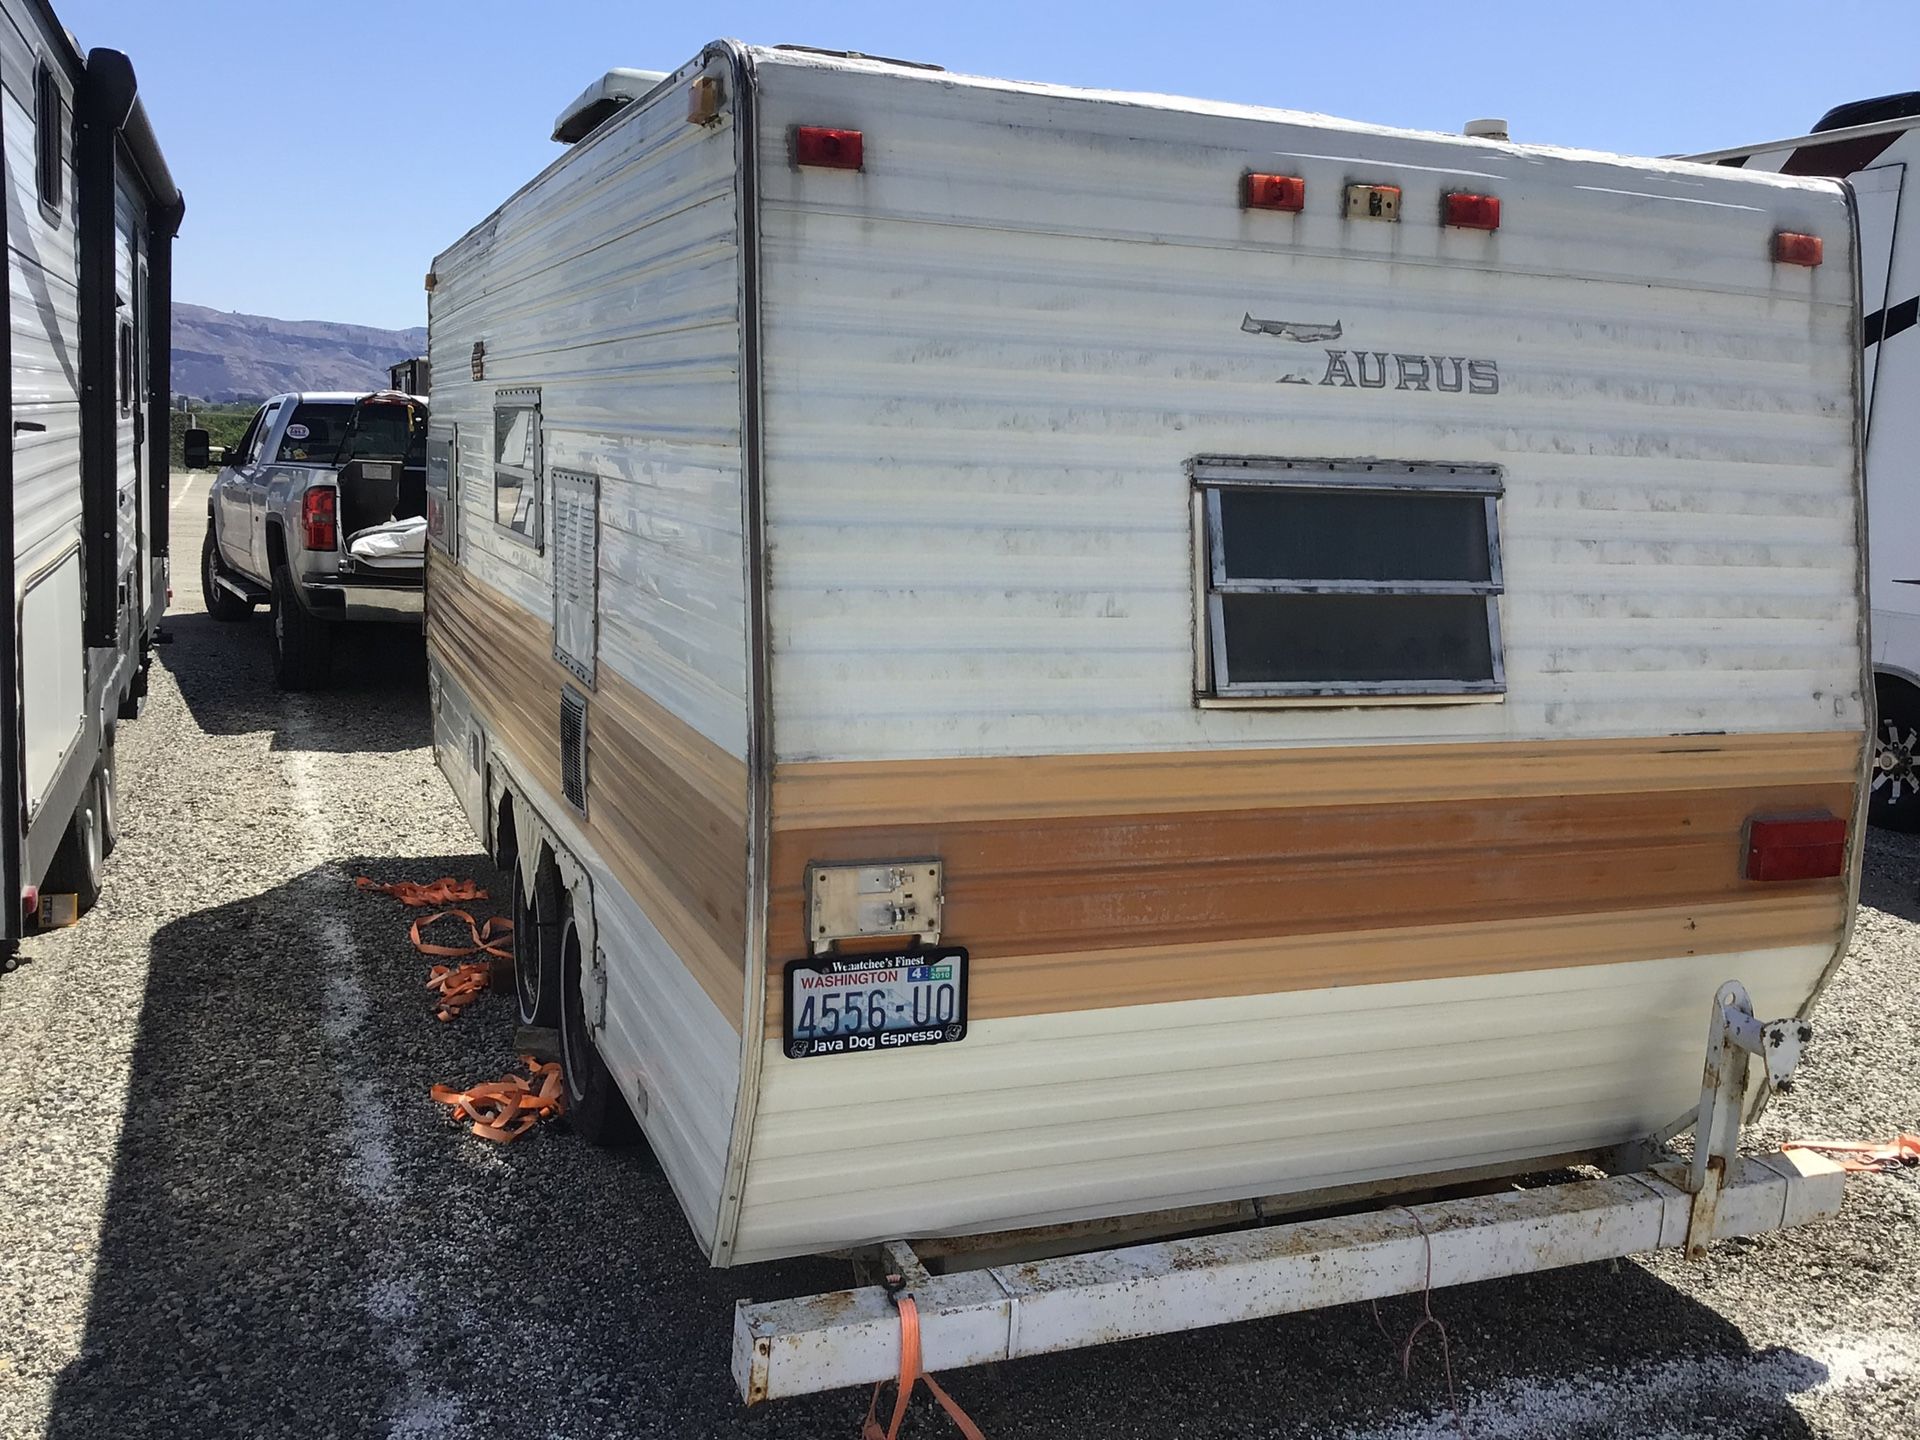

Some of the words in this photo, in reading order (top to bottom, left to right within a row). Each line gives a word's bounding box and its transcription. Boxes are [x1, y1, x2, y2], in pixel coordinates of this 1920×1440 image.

[895, 955, 925, 967] Finest
[801, 970, 898, 989] WASHINGTON
[912, 967, 922, 979] 4
[810, 1039, 844, 1053] Java
[849, 1035, 876, 1050] Dog
[880, 1029, 943, 1046] Espresso
